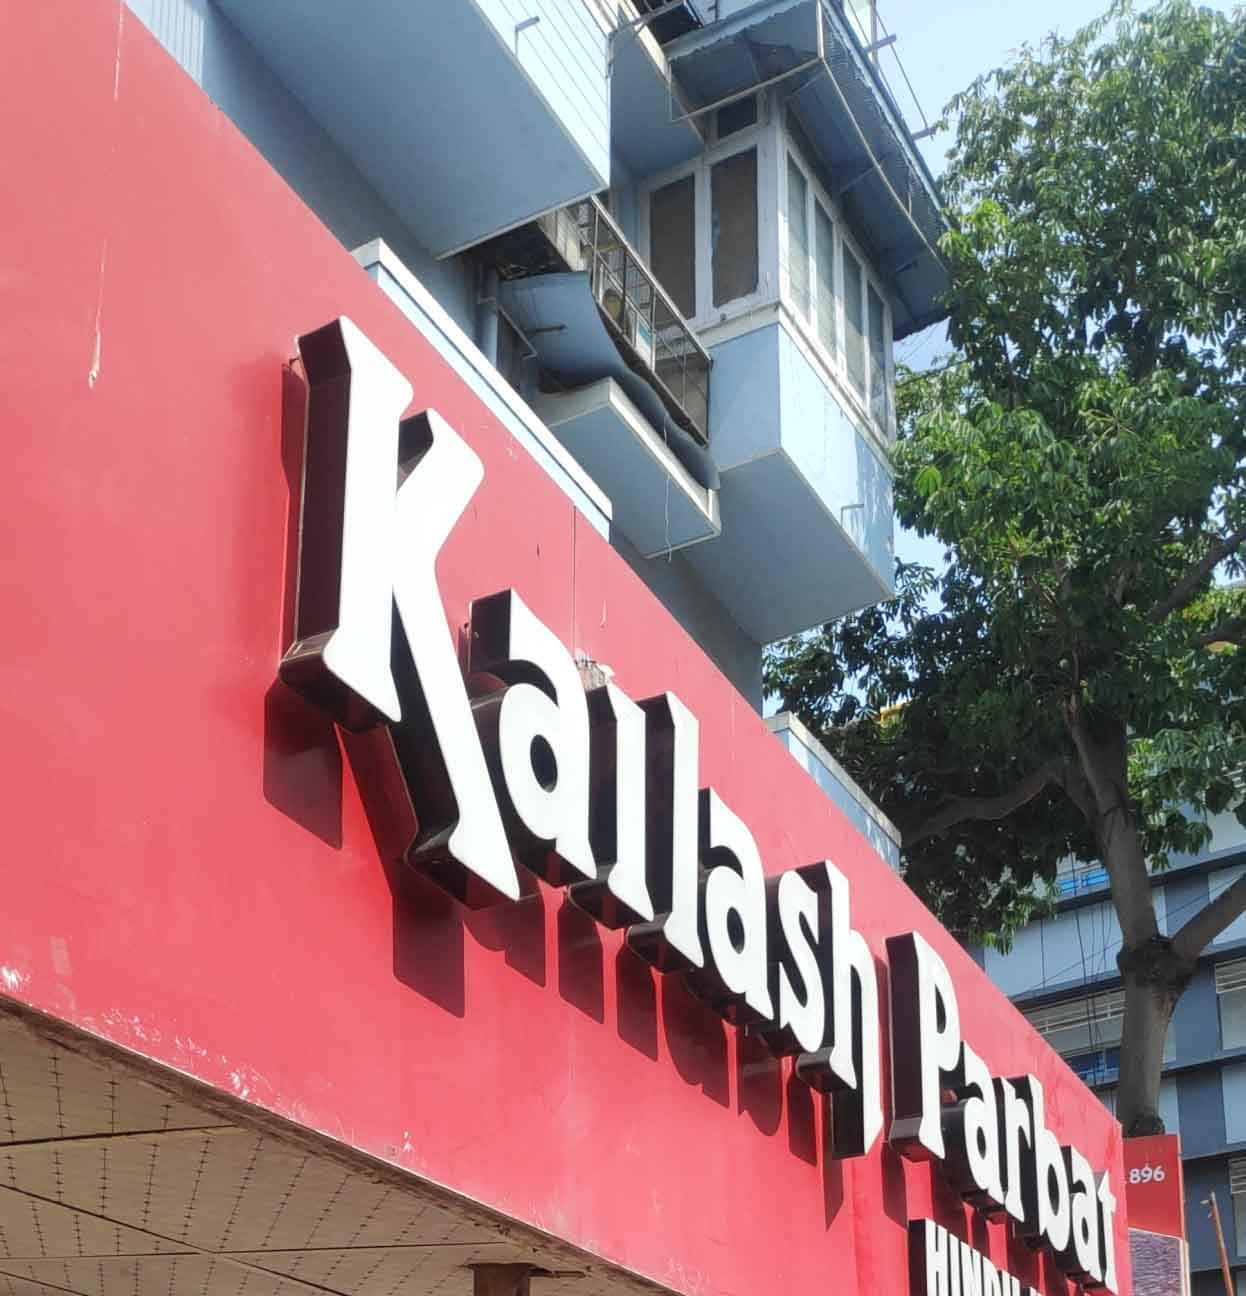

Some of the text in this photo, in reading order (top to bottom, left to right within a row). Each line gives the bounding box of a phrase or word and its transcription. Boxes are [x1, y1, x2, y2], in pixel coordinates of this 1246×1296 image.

[323, 315, 1119, 1296] Kailash Parbat
[1126, 1164, 1166, 1184] 896
